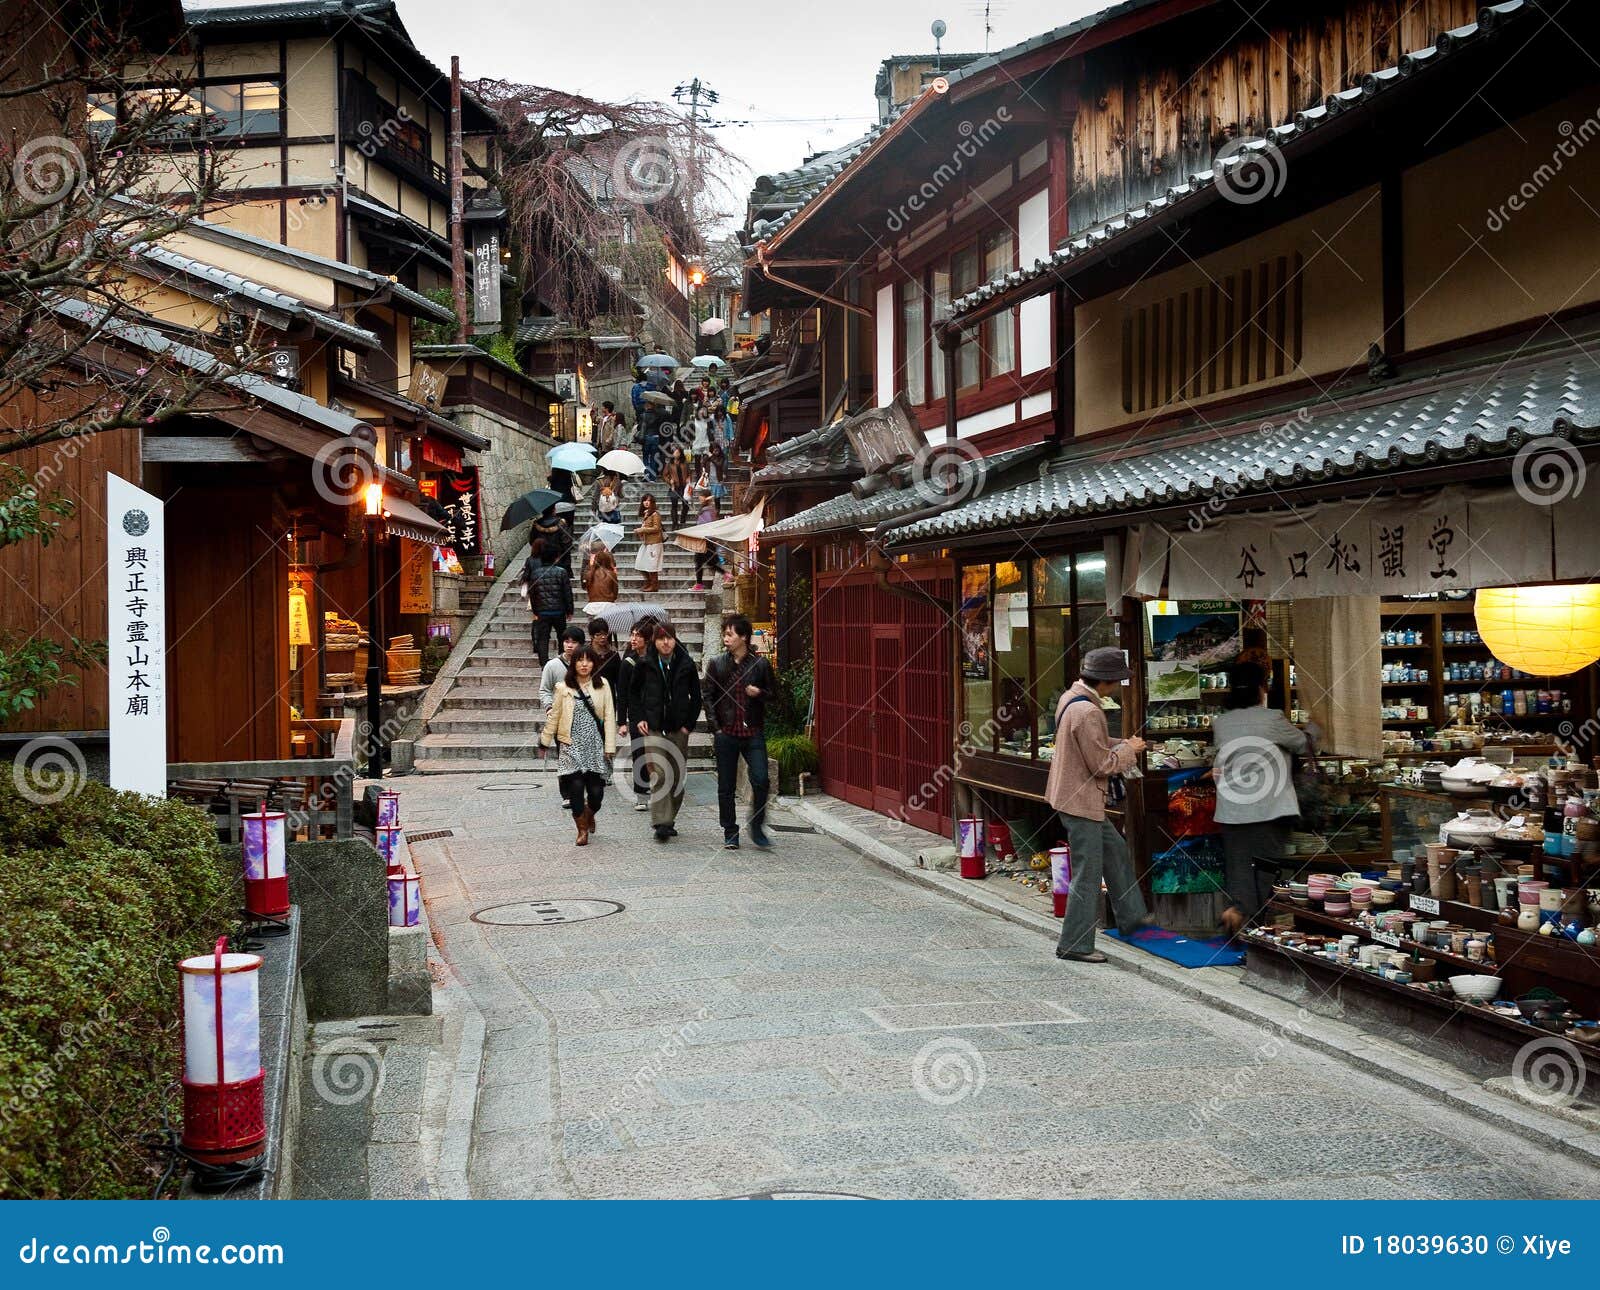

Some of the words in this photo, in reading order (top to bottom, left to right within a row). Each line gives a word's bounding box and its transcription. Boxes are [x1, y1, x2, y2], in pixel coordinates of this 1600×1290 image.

[459, 492, 476, 550] 世界一辛い
[124, 547, 151, 716] 興正寺霊山本廟
